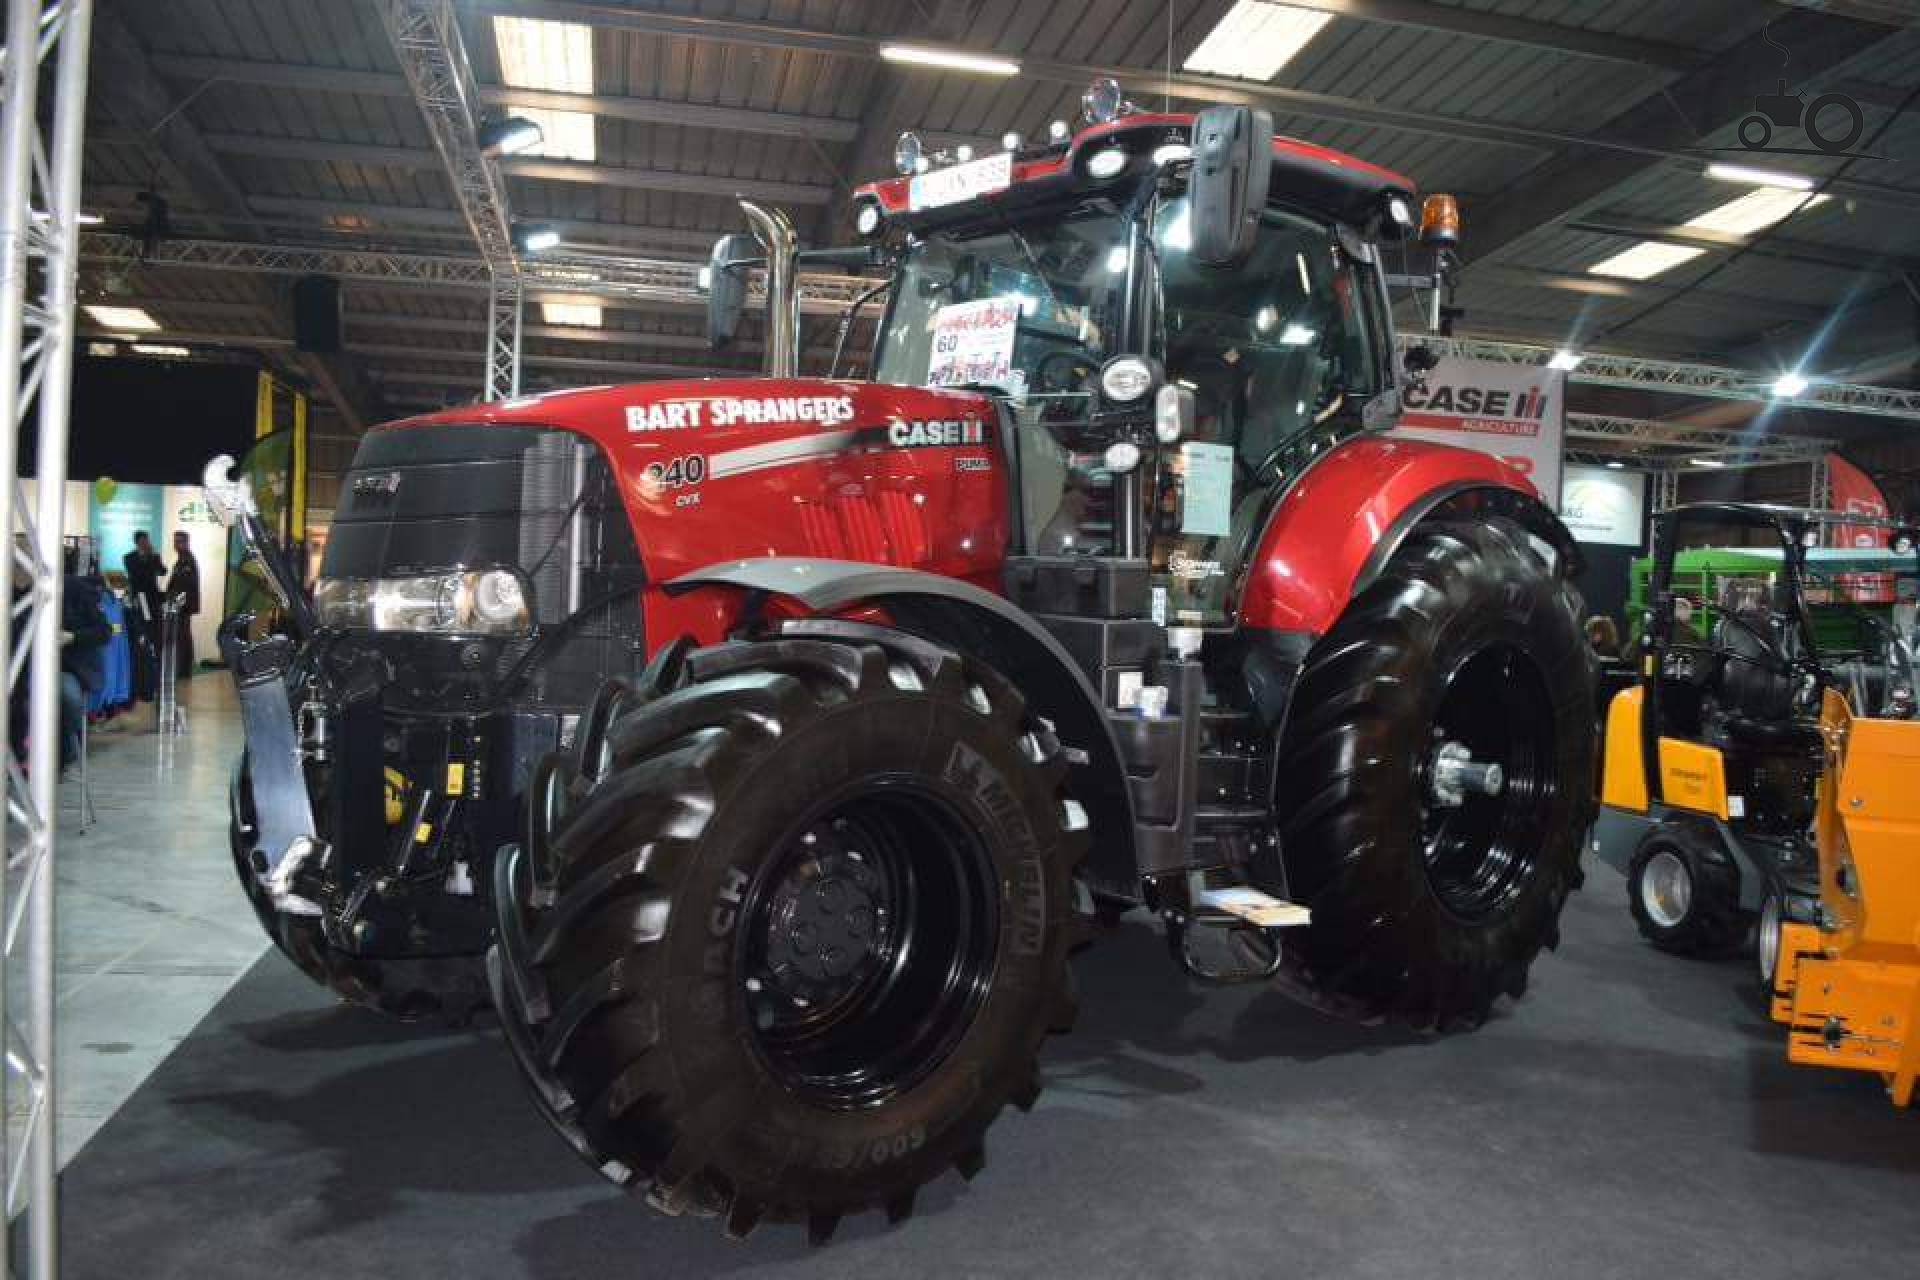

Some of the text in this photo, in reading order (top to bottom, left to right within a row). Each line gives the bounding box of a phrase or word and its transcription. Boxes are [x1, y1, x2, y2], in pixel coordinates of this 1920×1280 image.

[625, 397, 855, 432] BART SPRANGERS
[1402, 382, 1511, 416] CASE
[889, 418, 960, 446] CASE
